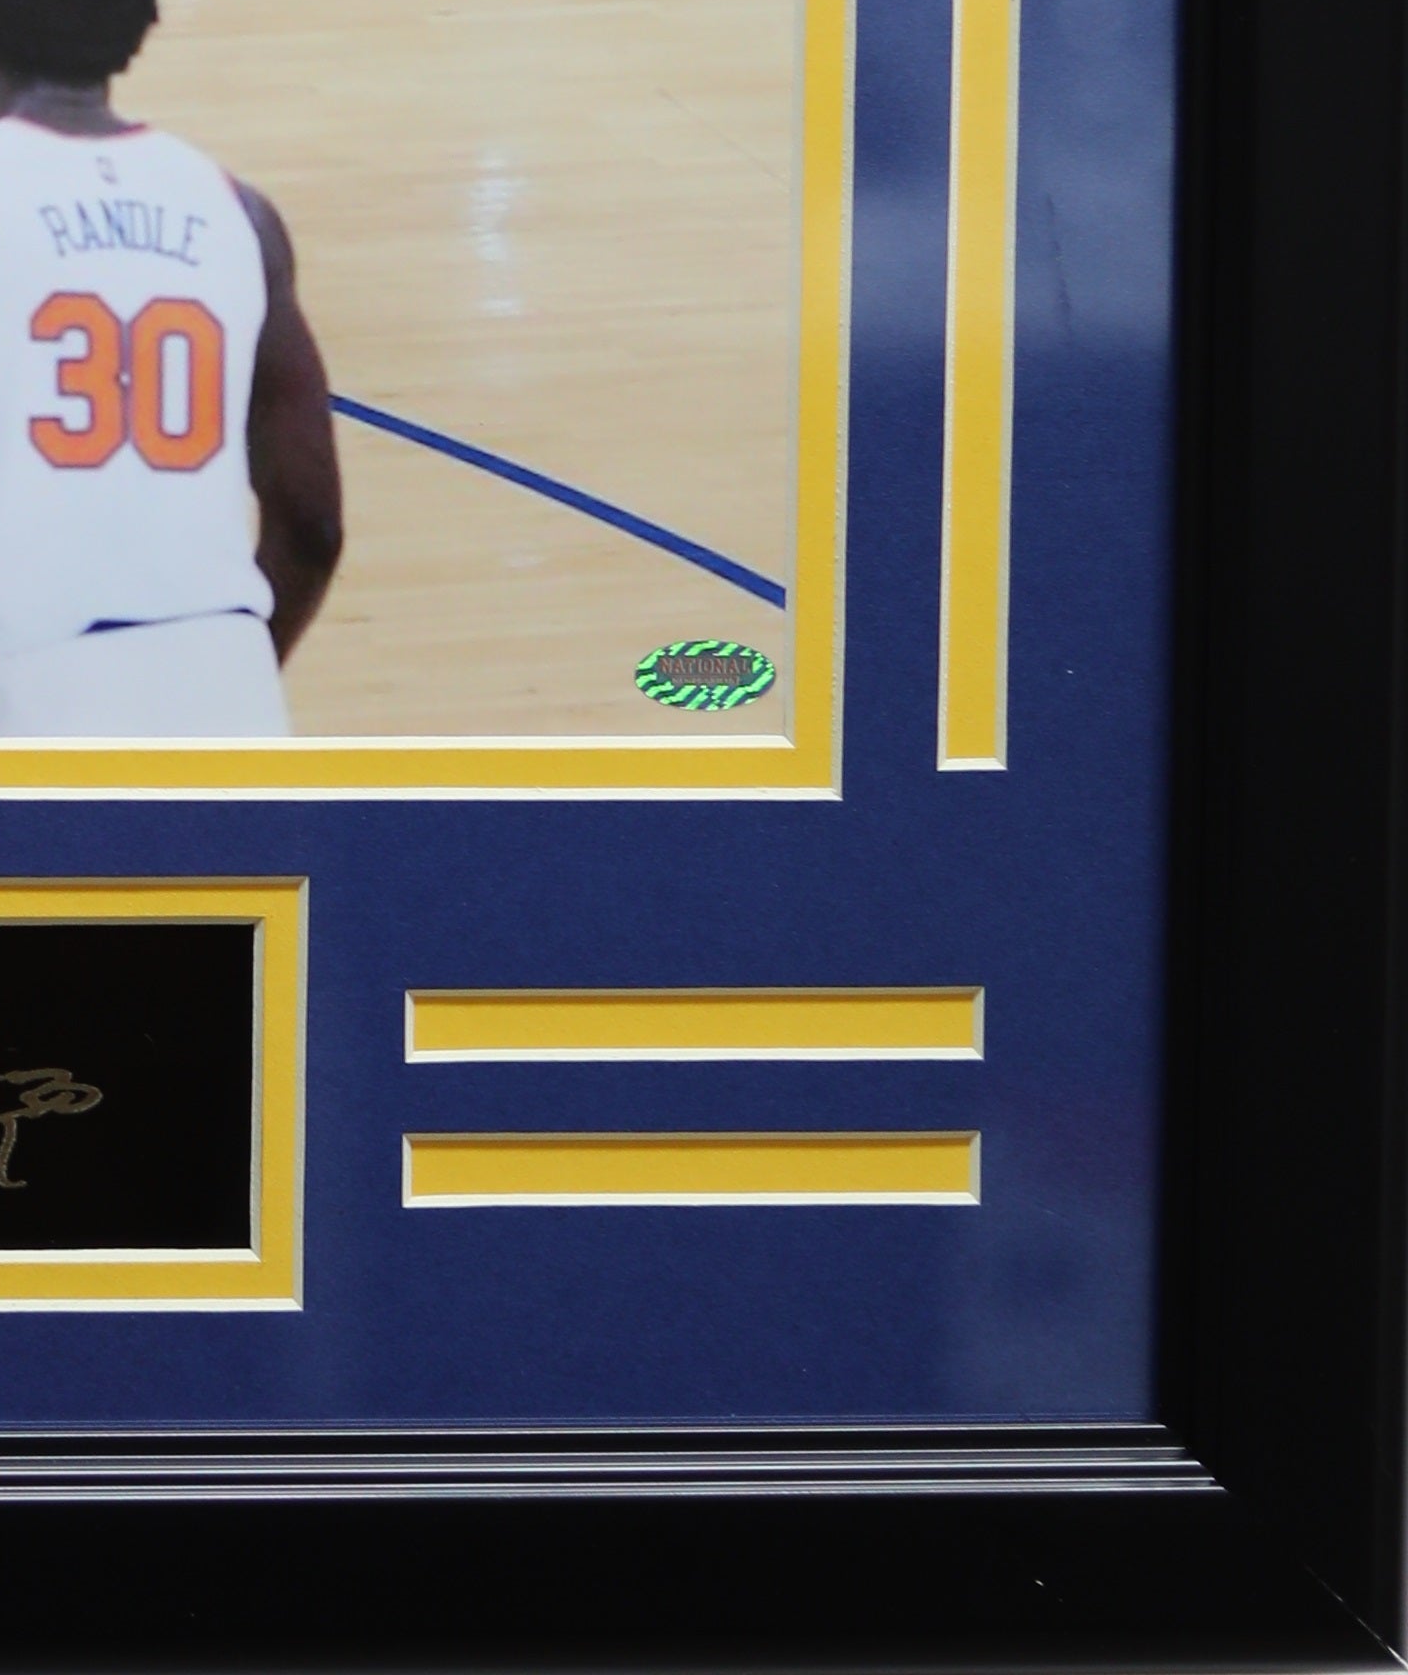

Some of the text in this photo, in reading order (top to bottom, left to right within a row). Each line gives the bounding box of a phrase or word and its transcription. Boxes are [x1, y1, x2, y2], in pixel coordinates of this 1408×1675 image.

[39, 199, 207, 266] RANDLE
[29, 291, 225, 473] 30
[658, 657, 752, 674] NATIONAL
